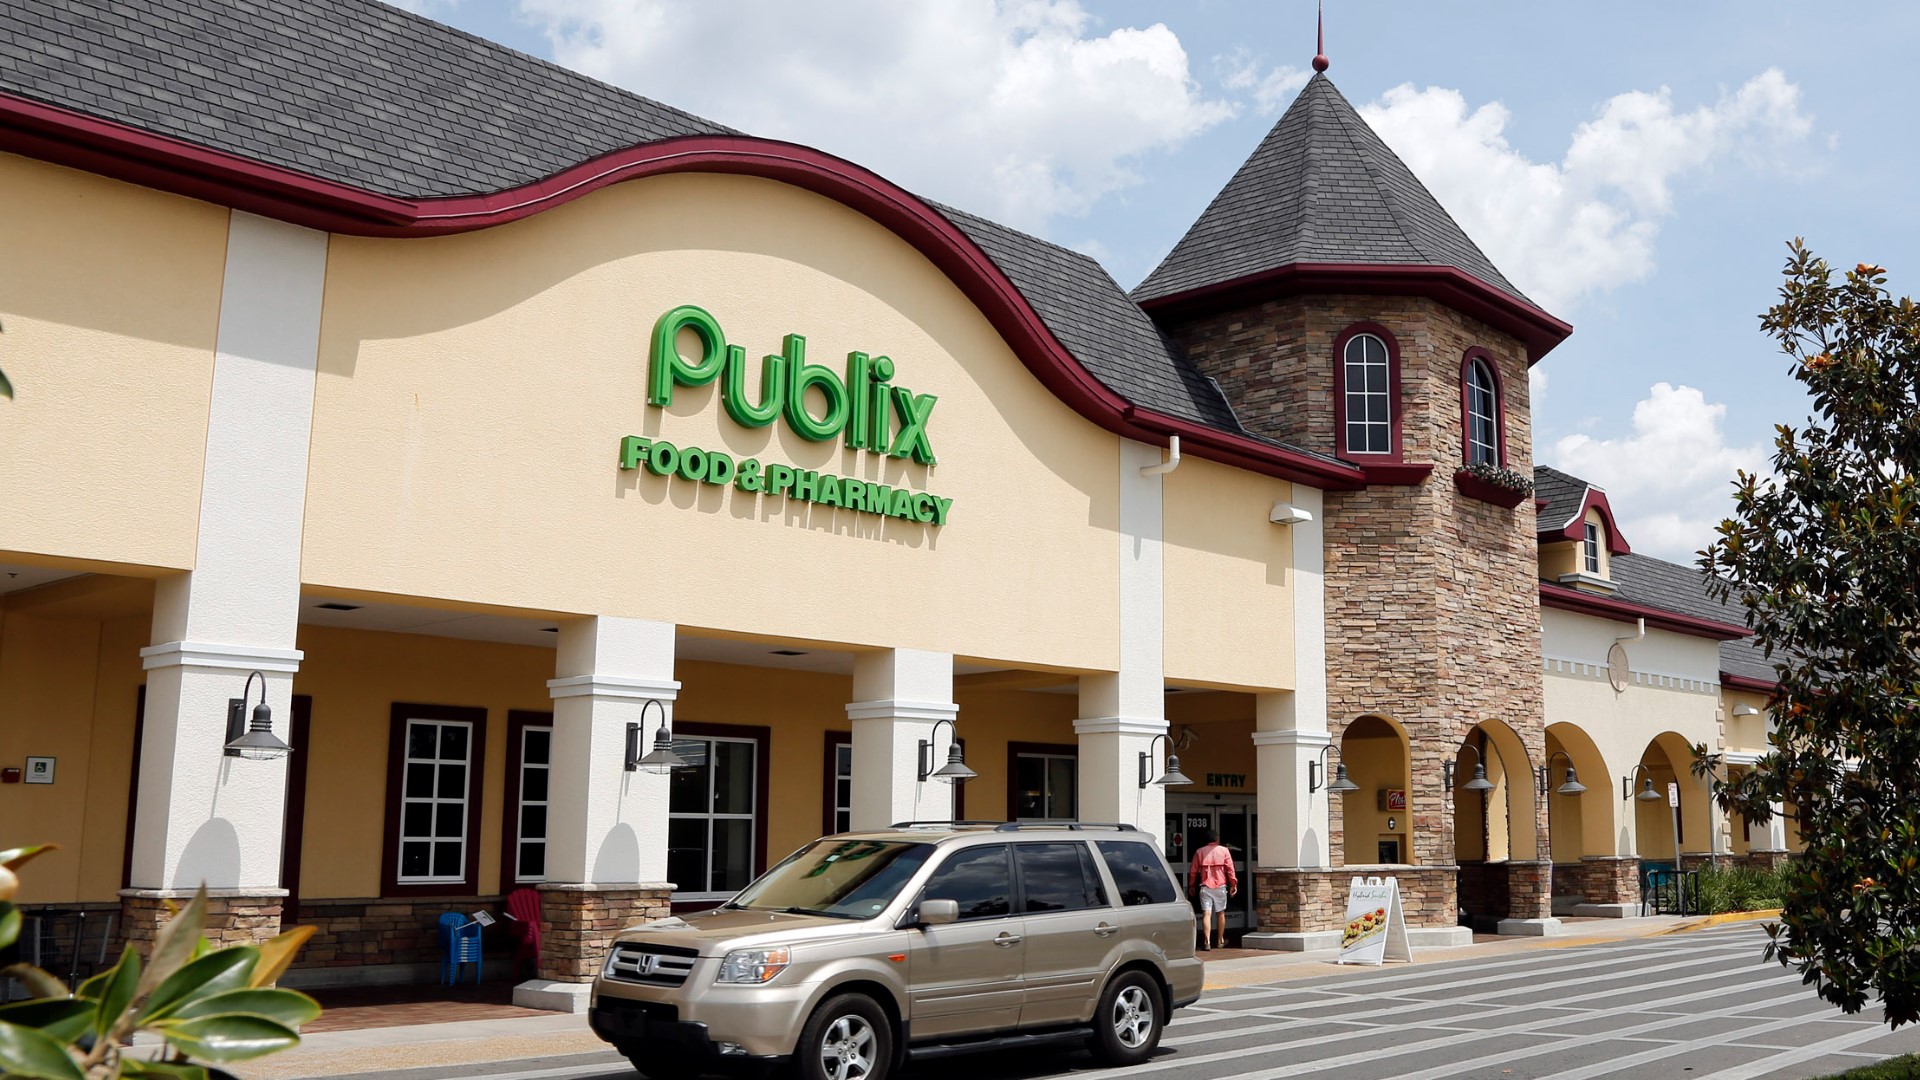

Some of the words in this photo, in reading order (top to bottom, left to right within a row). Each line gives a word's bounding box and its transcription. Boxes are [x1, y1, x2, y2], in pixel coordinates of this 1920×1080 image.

[648, 304, 939, 468] Publix
[620, 435, 735, 486] FOOD
[765, 463, 954, 526] PHARMACY
[1206, 773, 1246, 788] ENTRY
[1187, 818, 1208, 828] 7838
